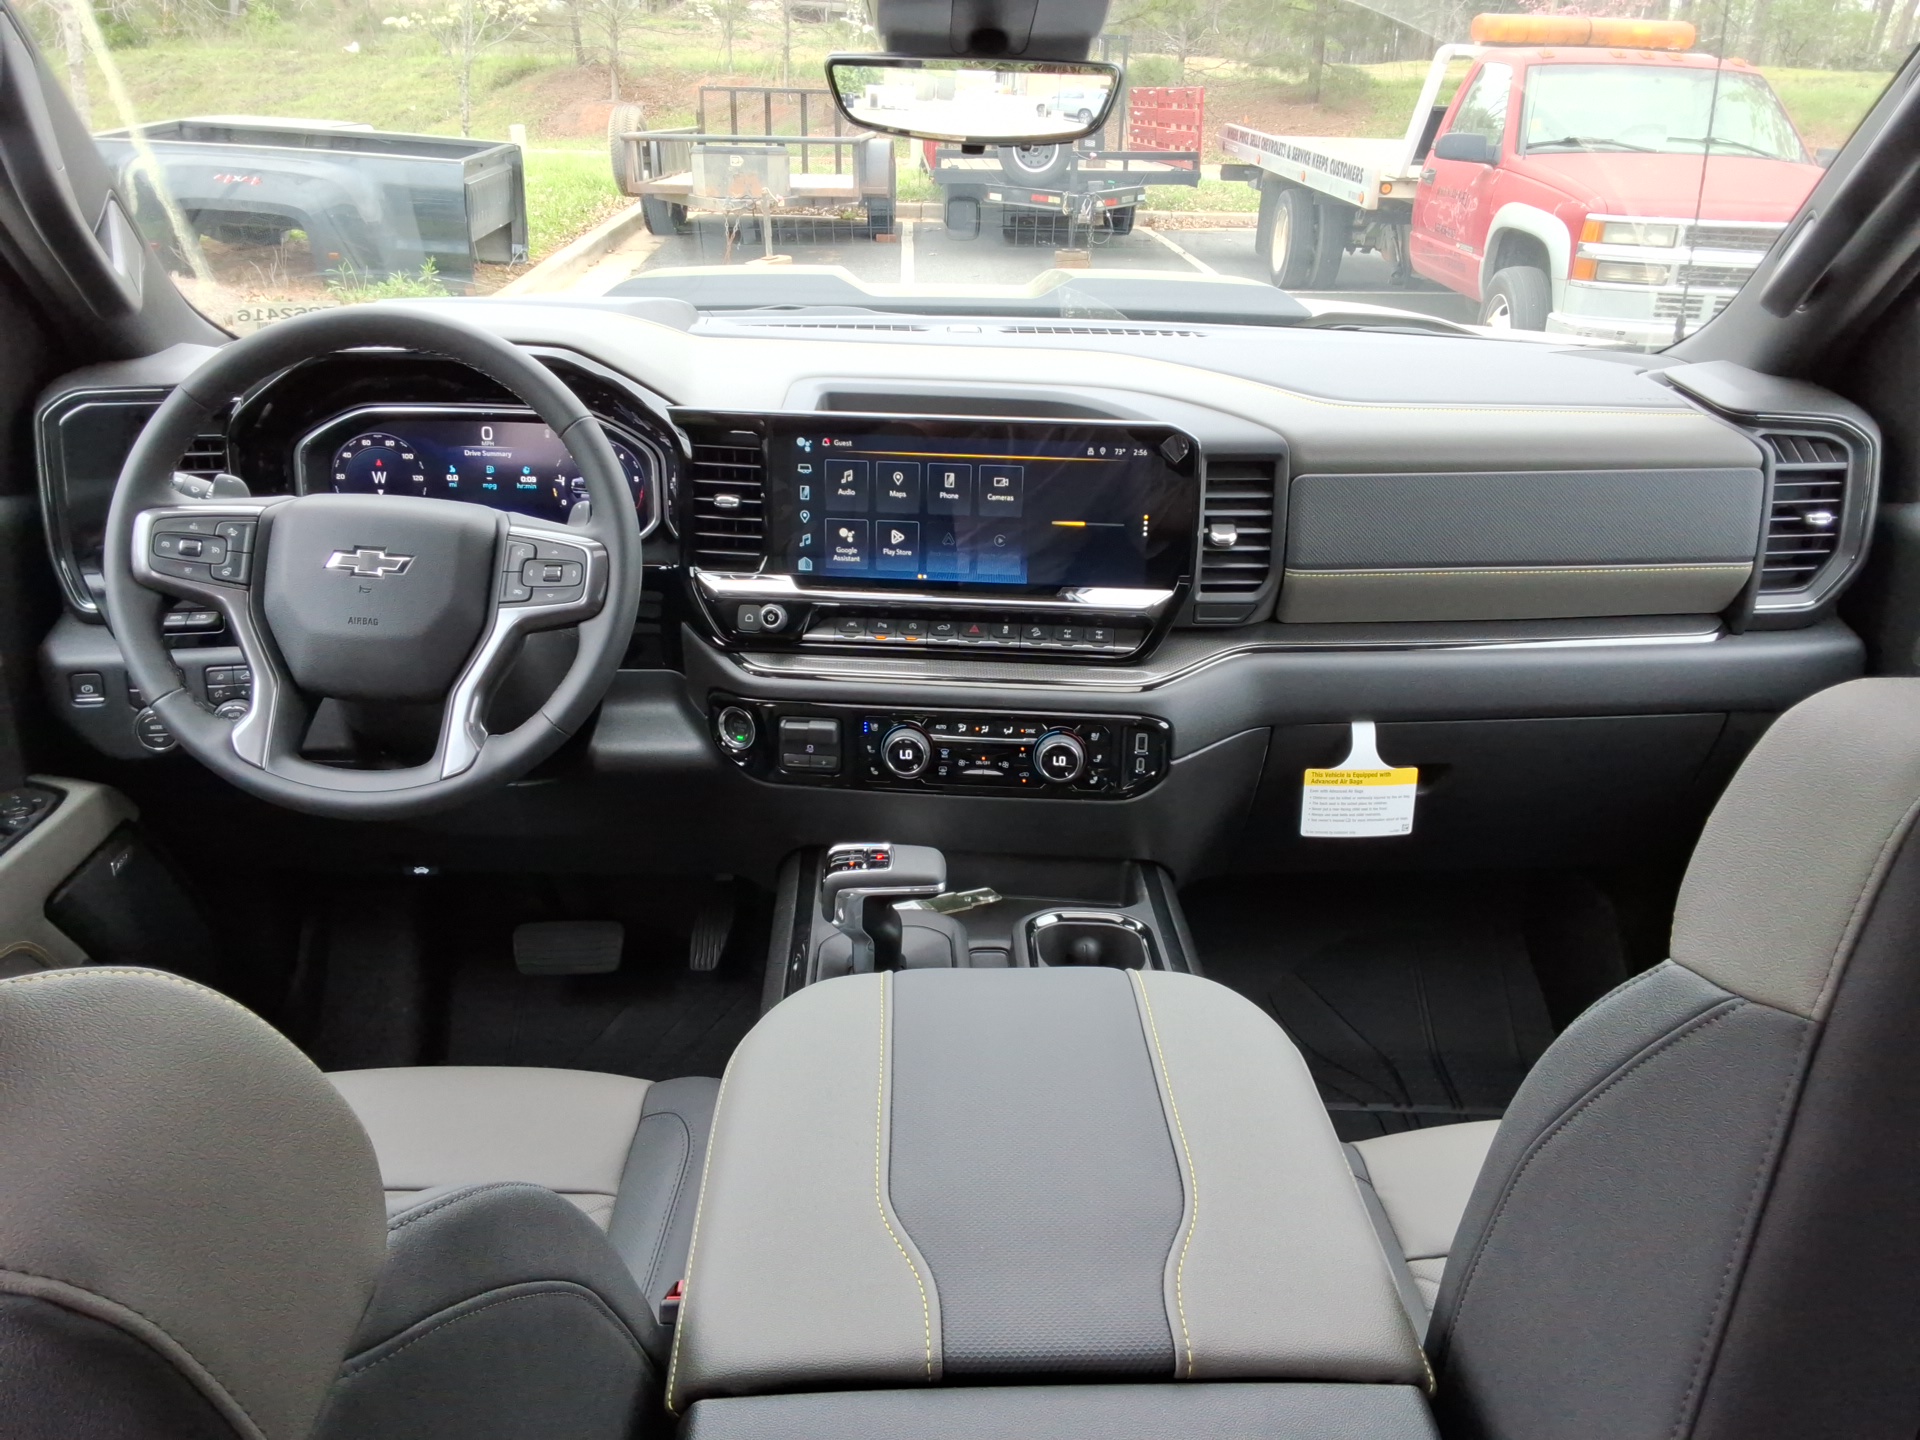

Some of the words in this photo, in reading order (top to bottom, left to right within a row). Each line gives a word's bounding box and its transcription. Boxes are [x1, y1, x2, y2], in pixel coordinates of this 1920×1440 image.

[1292, 146, 1311, 167] SERVICE
[1312, 152, 1329, 173] KEEPS
[1330, 158, 1364, 184] CUSTOMERS
[481, 426, 493, 441] 0
[833, 439, 852, 447] Guest
[482, 450, 512, 458] Summary
[371, 471, 387, 484] W
[837, 488, 856, 496] Audio
[889, 490, 907, 498] Maps
[987, 493, 1014, 501] Cameras
[836, 547, 858, 555] Google
[883, 548, 895, 556] Play
[347, 617, 379, 626] AIRBAG
[1352, 772, 1379, 780] Equipped
